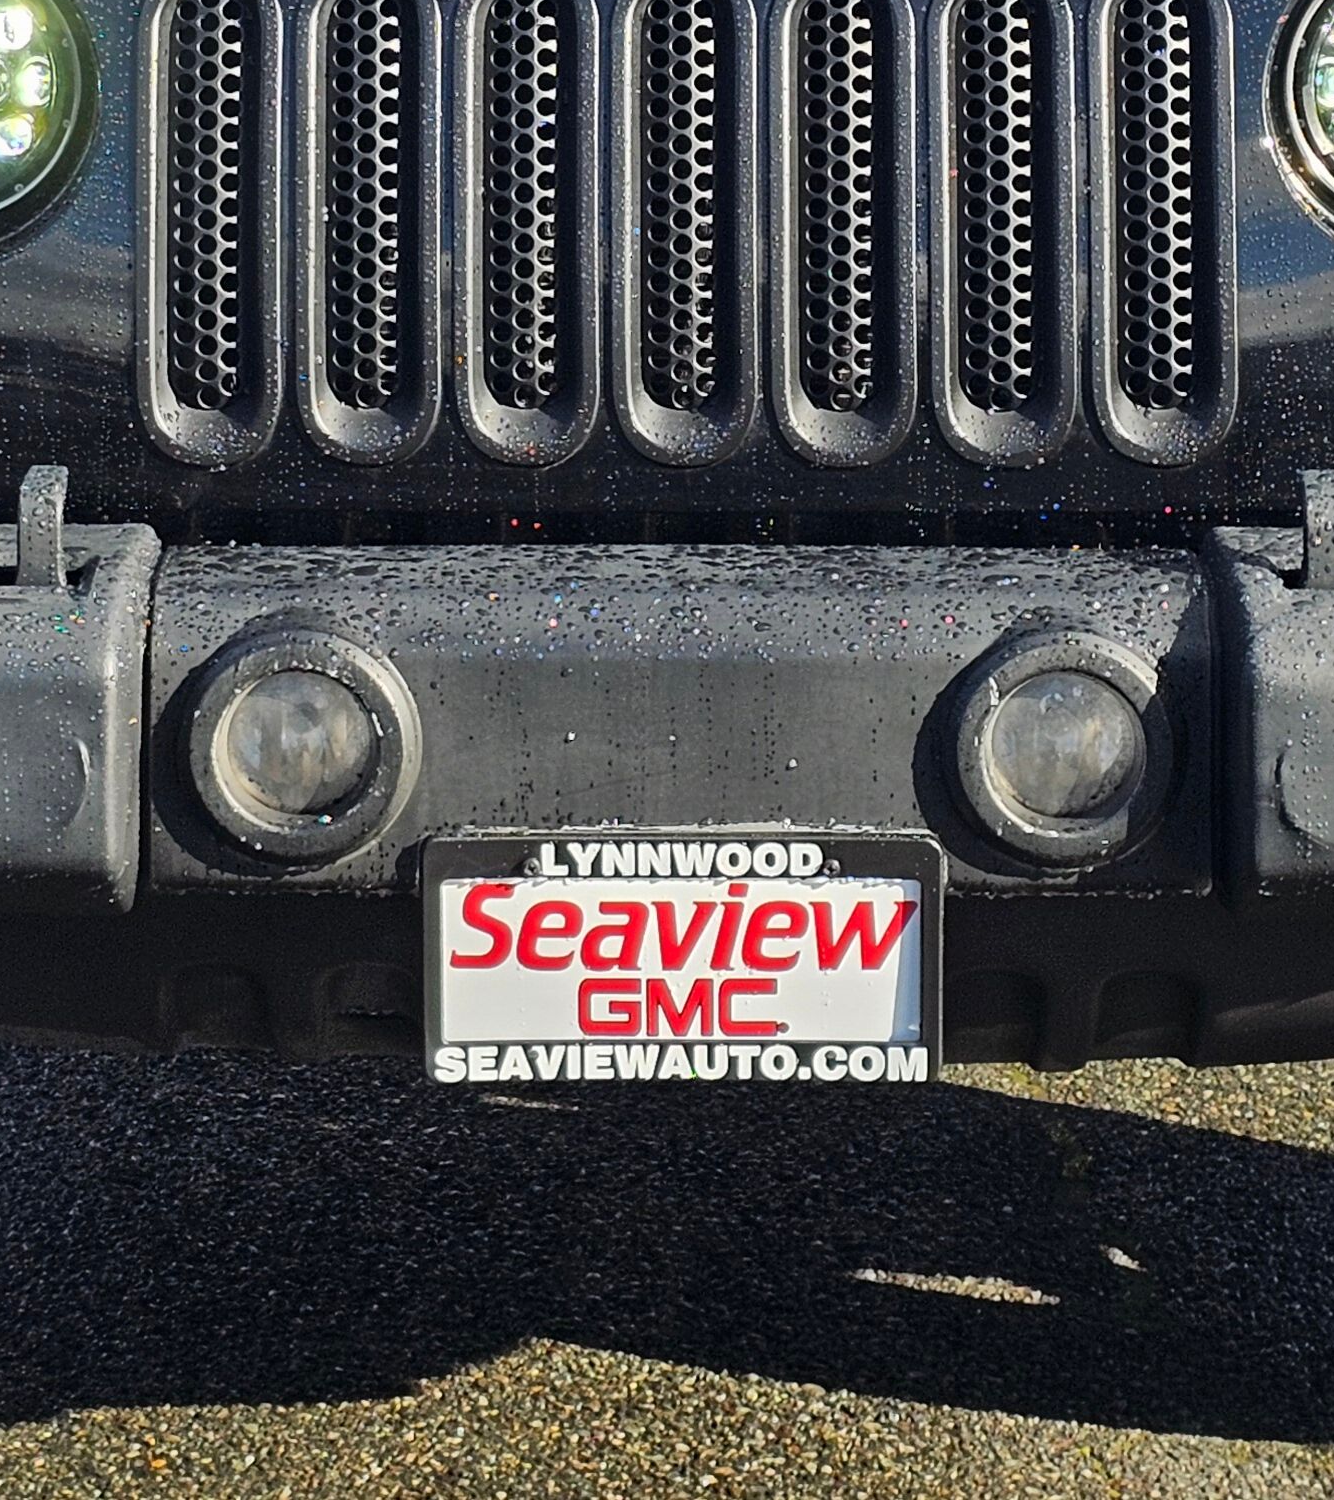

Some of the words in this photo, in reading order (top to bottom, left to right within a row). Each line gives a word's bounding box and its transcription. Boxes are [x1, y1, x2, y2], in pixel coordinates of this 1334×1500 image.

[540, 842, 824, 878] LYNNWOOD
[449, 883, 919, 972] Seaview
[577, 978, 780, 1037] GMC
[433, 1044, 929, 1084] SEAVIEWAUTO.COM
